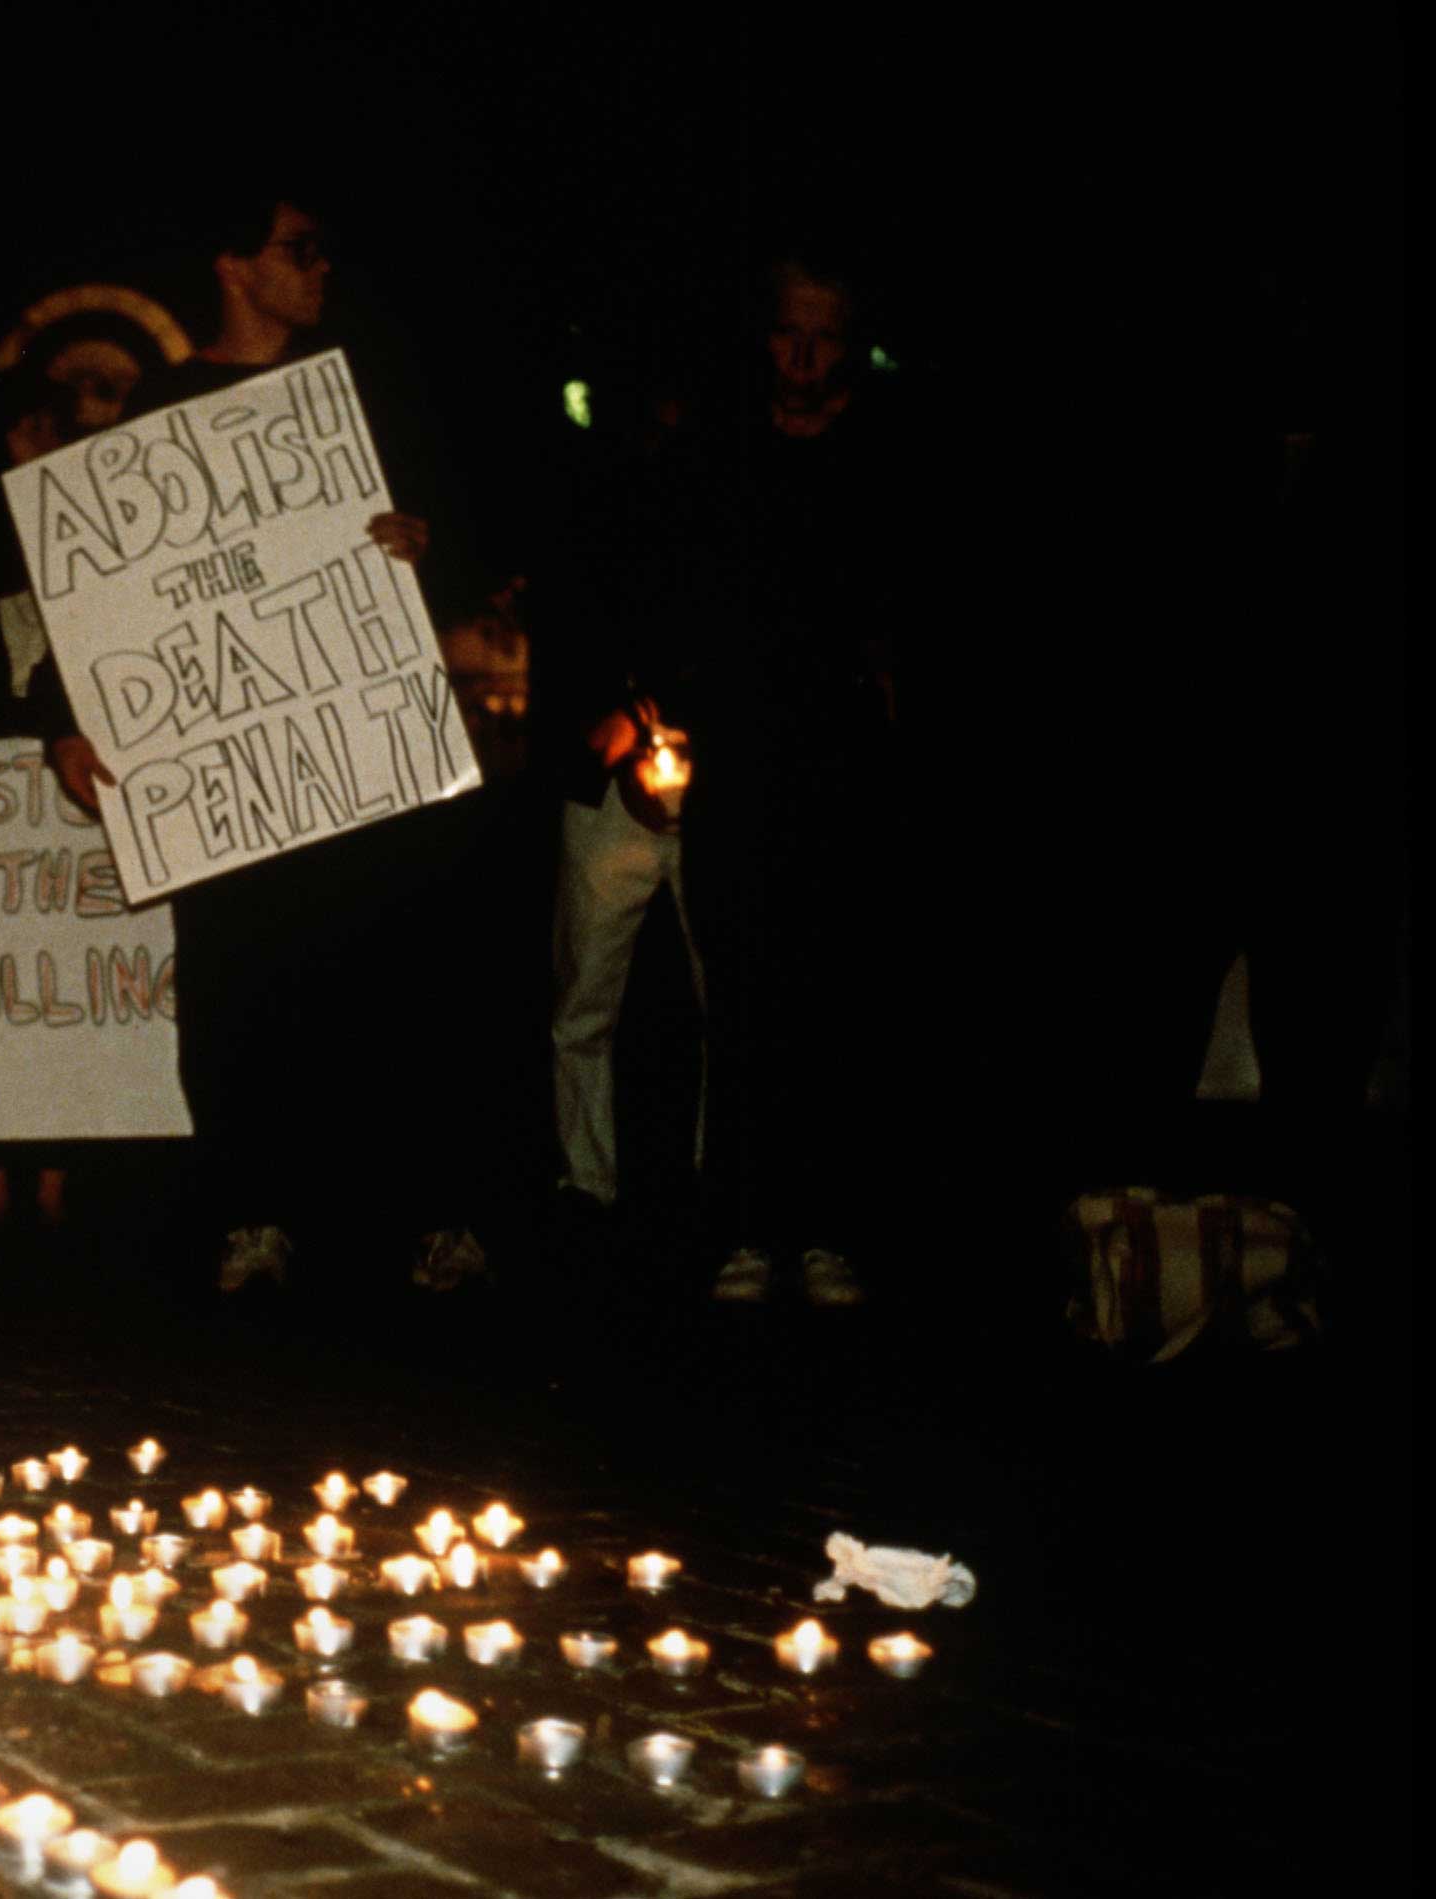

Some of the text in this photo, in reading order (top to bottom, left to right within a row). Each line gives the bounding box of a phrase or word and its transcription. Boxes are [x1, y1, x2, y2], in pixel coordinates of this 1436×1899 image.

[90, 542, 423, 752] DEATH
[153, 540, 265, 612] THE
[121, 662, 454, 890] PENALTY
